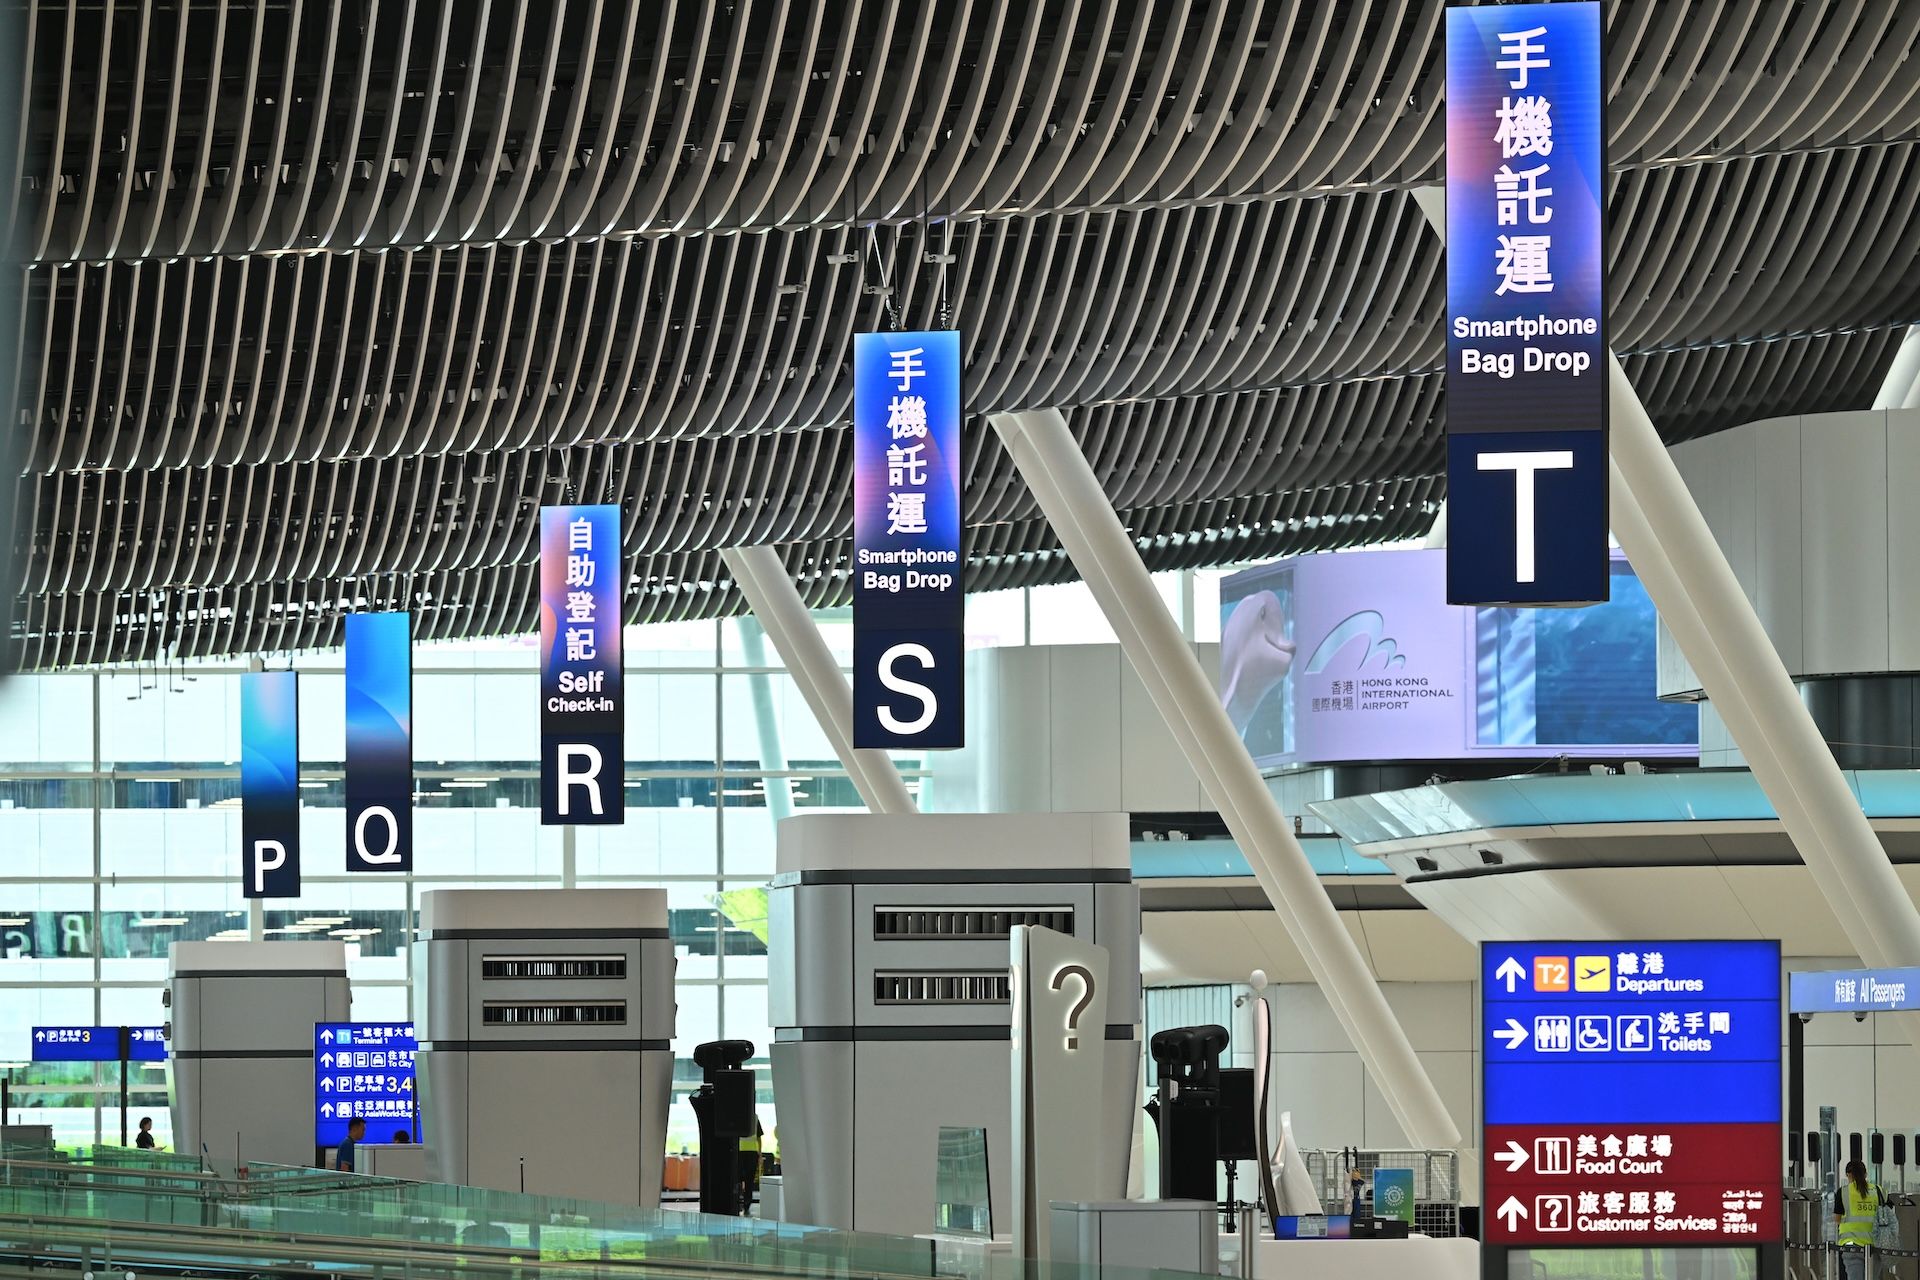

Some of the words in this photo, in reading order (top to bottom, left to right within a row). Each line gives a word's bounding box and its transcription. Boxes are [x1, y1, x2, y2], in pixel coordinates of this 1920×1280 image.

[1493, 26, 1555, 296] 手機託運
[1453, 314, 1598, 341] Smartphone
[1461, 348, 1515, 378] Bag
[1523, 347, 1591, 376] Drop
[886, 347, 929, 536] 手機託運
[1477, 451, 1573, 582] T
[858, 548, 957, 566] Smartphone
[565, 516, 597, 661] 自助登記
[863, 571, 901, 592] Bag
[906, 570, 953, 591] Drop
[558, 670, 604, 693] Self
[876, 642, 938, 735] S
[1331, 680, 1354, 695] 香港
[1361, 678, 1392, 687] HONG
[1395, 677, 1429, 686] KONG
[547, 696, 614, 713] Check-in
[1312, 697, 1354, 712] 國際機場
[1361, 688, 1454, 699] INTERNATIONAL
[1361, 701, 1409, 711] AIRPORT
[557, 743, 604, 816] R
[354, 805, 402, 865] Q
[254, 839, 287, 892] P
[1537, 963, 1567, 985] T2
[1616, 952, 1665, 976] 離港
[1616, 976, 1704, 994] Departures
[1860, 977, 1869, 1003] All
[1870, 977, 1905, 1008] Passengers
[1657, 1011, 1731, 1035] 洗手間
[82, 1030, 91, 1042] 3
[353, 1037, 382, 1045] Terminal
[1657, 1035, 1712, 1052] Toilets
[398, 1060, 412, 1068] City
[354, 1110, 364, 1118] To
[1576, 1134, 1673, 1157] 美食廣場
[1575, 1158, 1616, 1174] Food
[1618, 1158, 1664, 1174] Court
[1576, 1190, 1677, 1214] 旅客服務
[1576, 1215, 1651, 1232] Customer
[1653, 1214, 1718, 1231] Services
